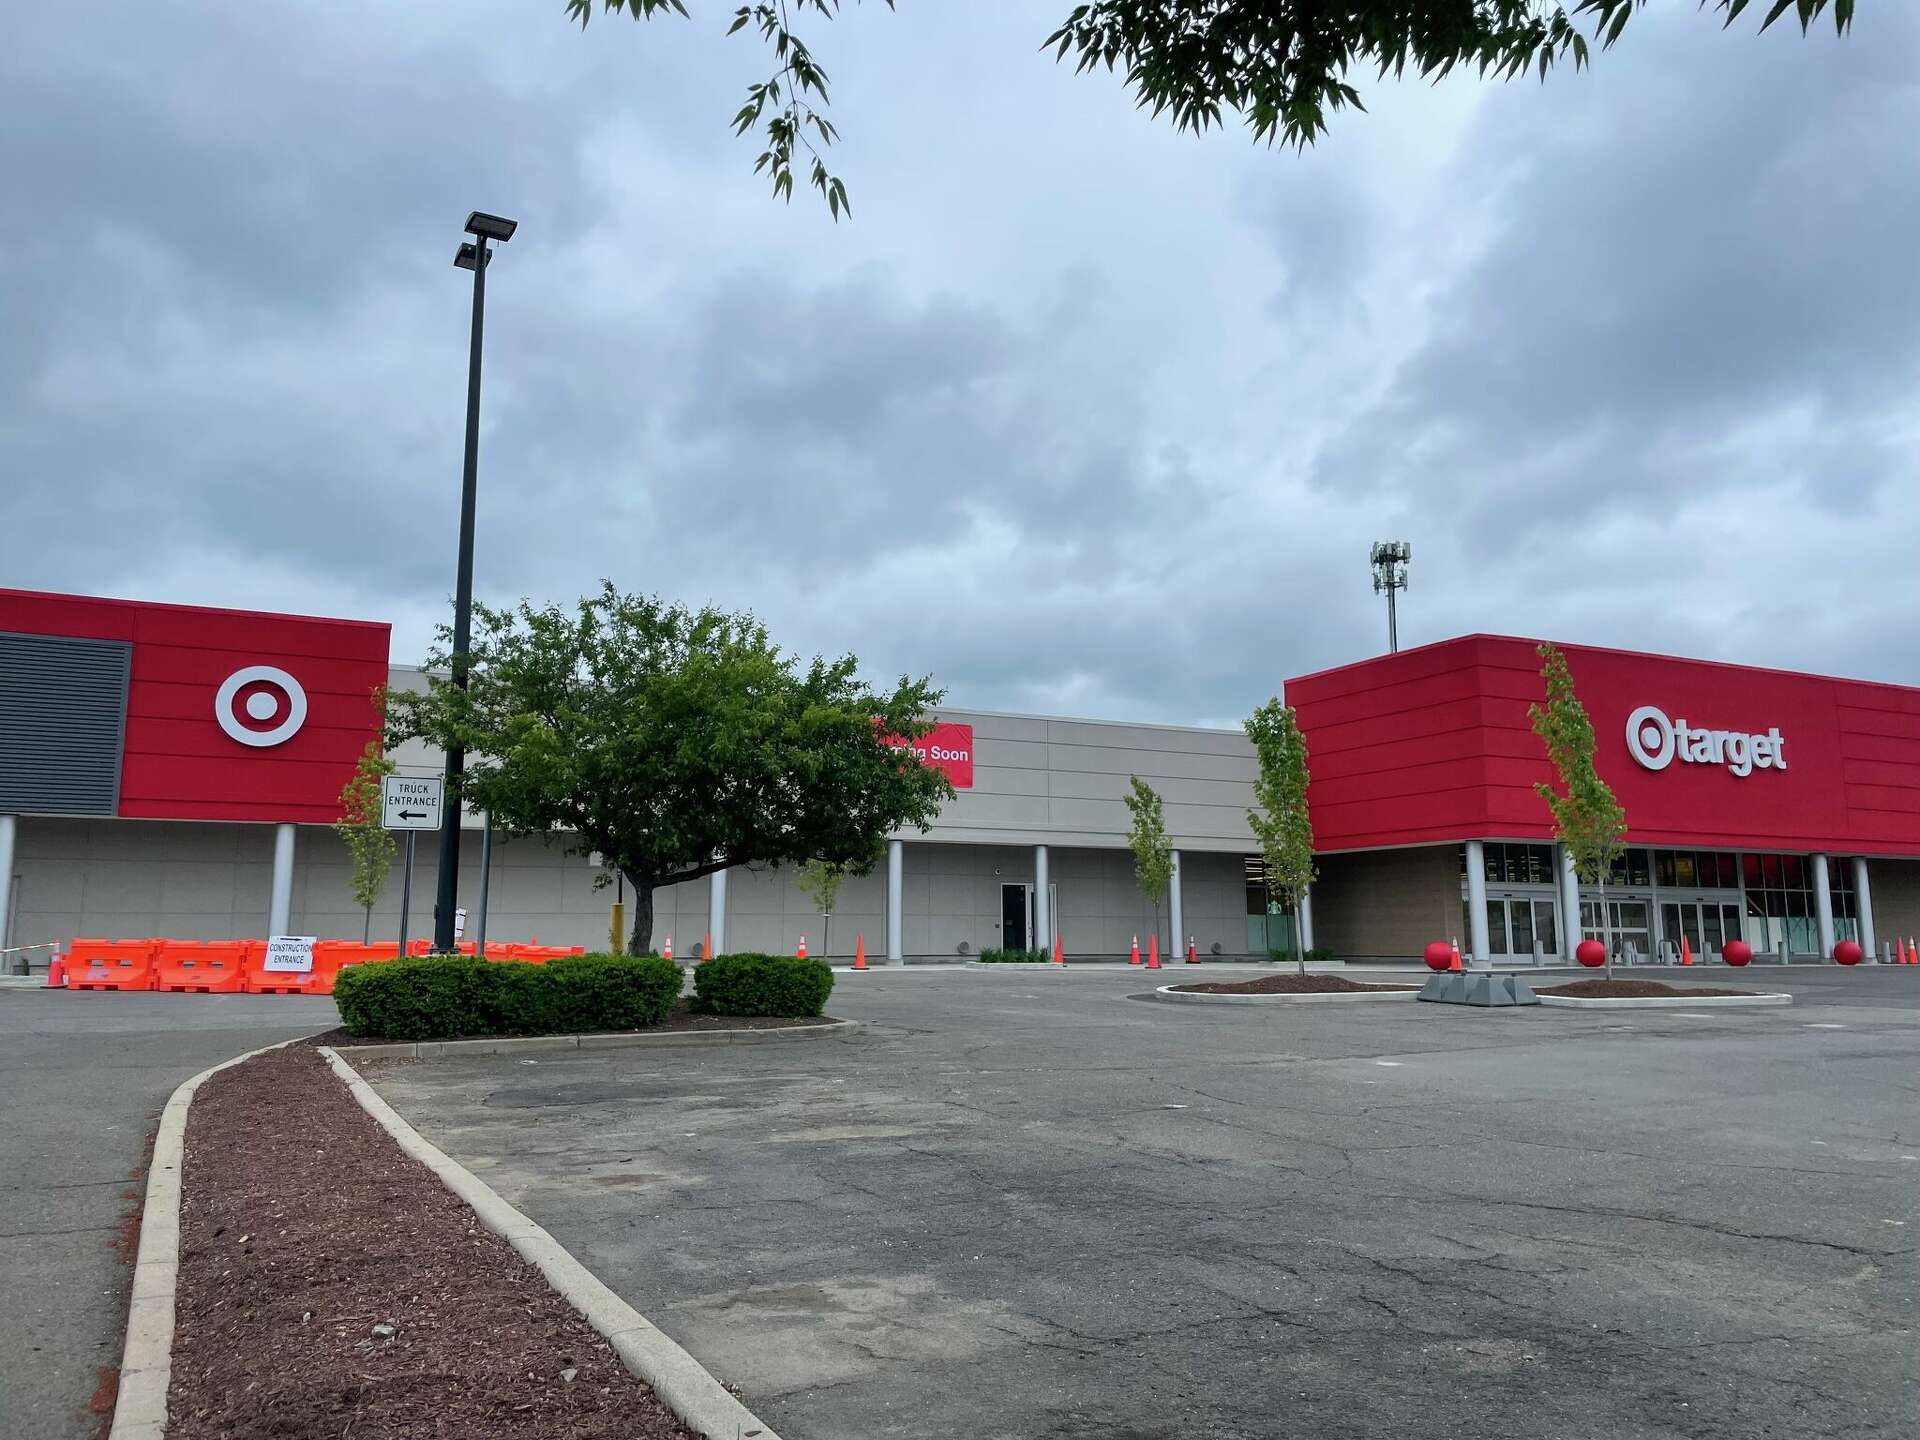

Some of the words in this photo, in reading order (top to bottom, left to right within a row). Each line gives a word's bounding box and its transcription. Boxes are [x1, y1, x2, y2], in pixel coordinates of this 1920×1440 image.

[1674, 718, 1787, 777] target
[930, 745, 968, 761] Soon
[399, 784, 429, 794] TRUCK
[388, 796, 437, 807] ENTRANCE
[269, 943, 313, 953] CONSTRUCTION
[273, 954, 305, 964] ENTRANCE
